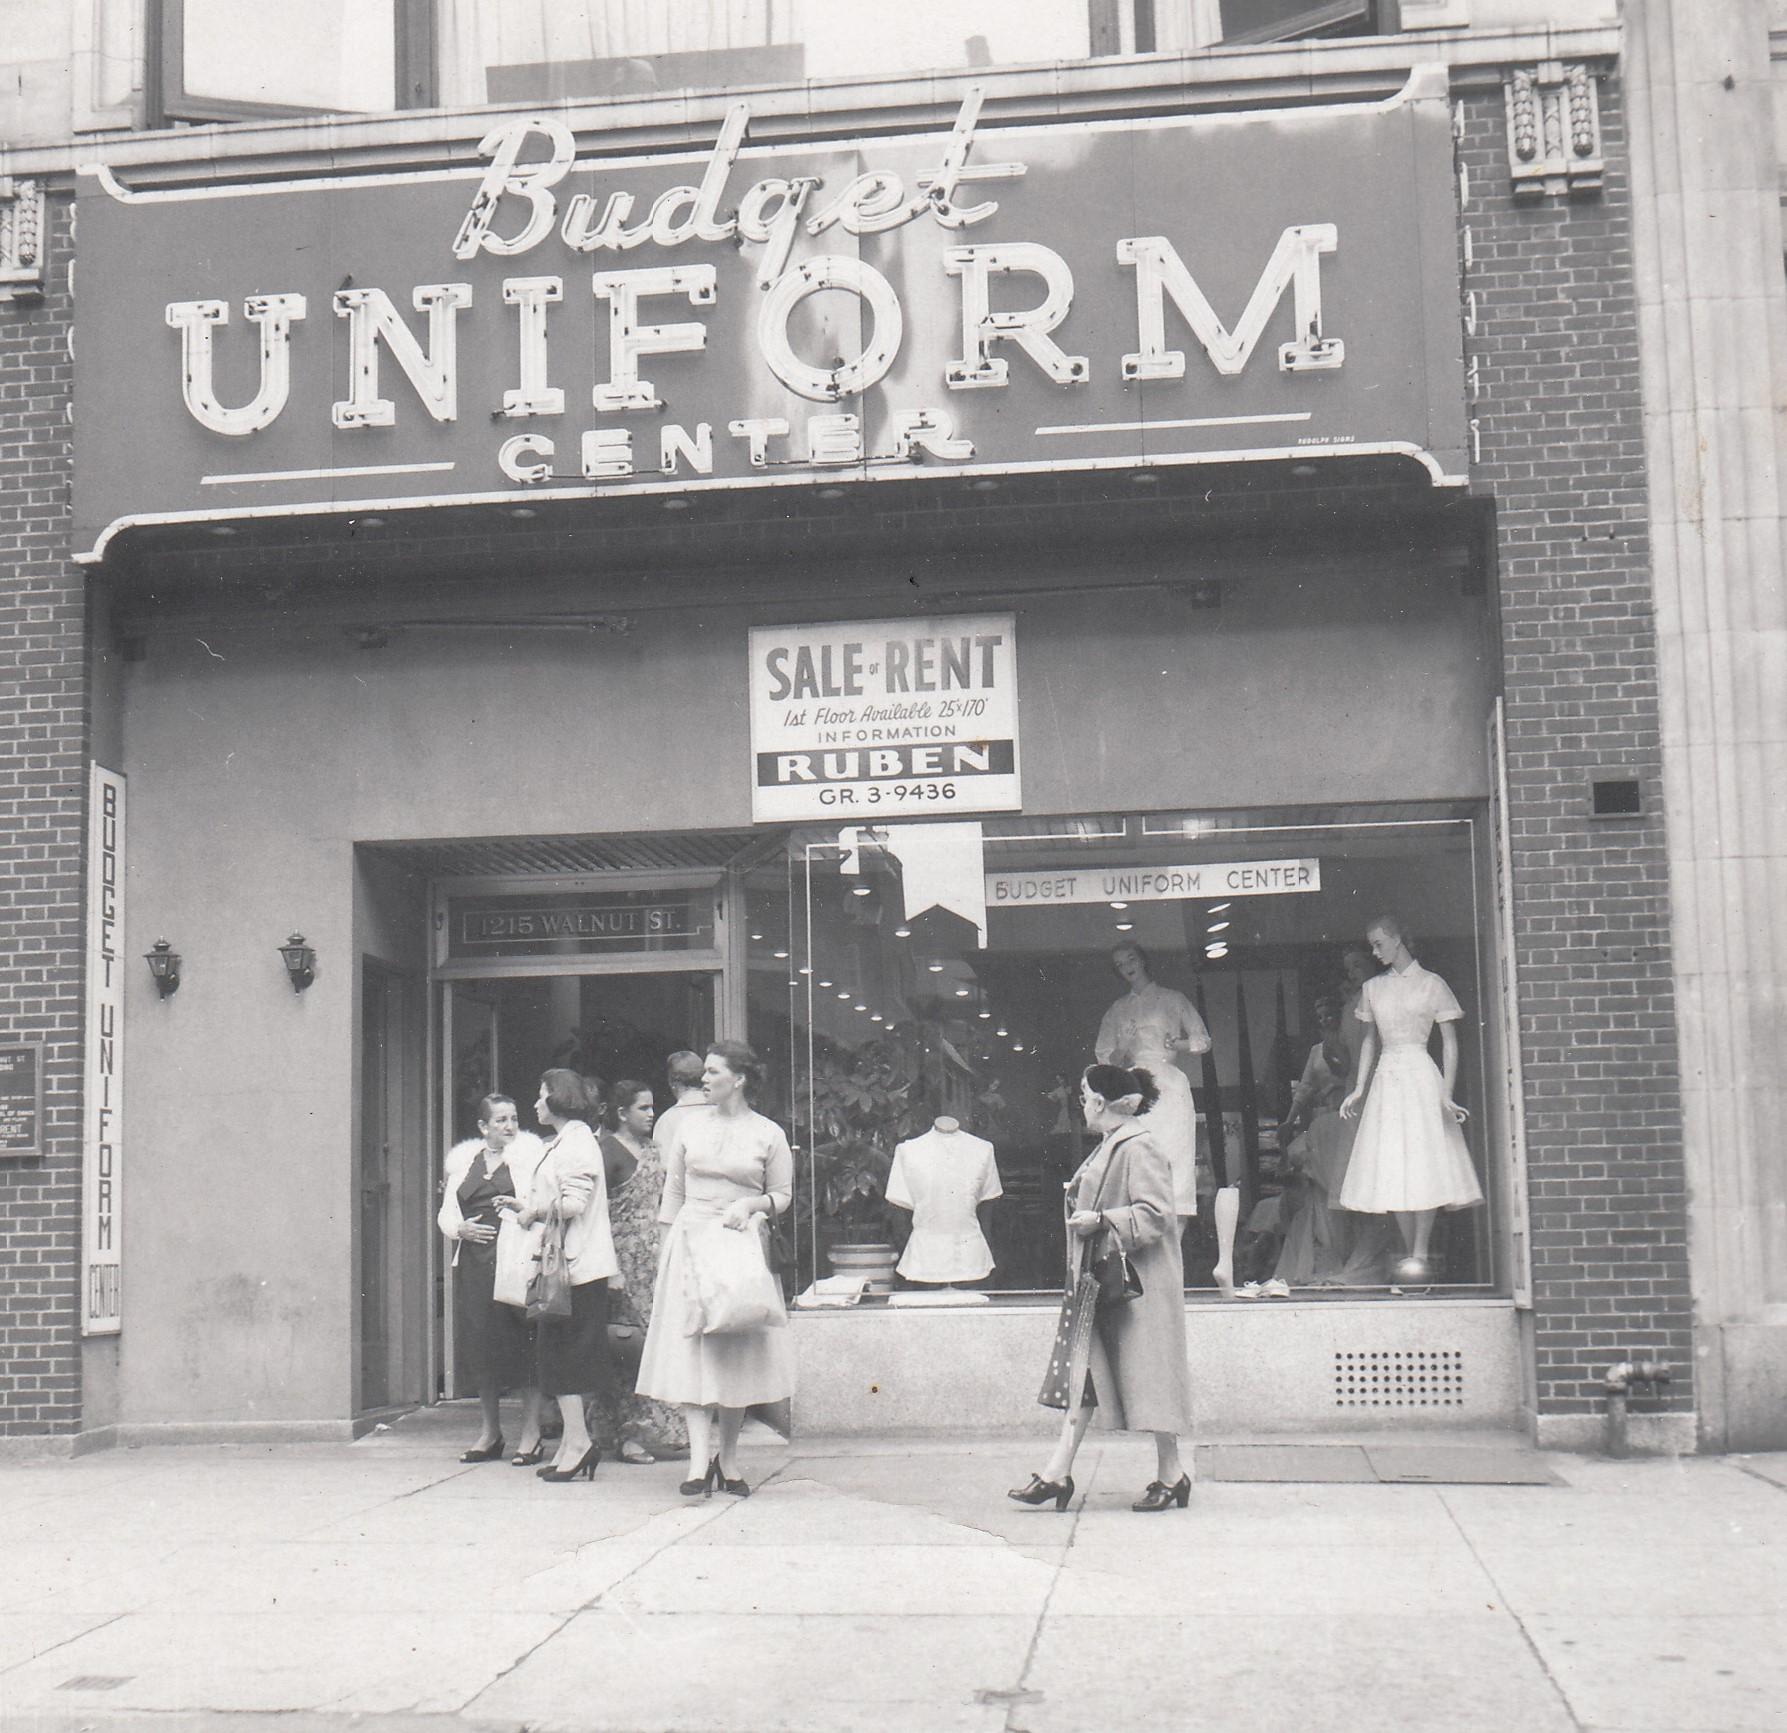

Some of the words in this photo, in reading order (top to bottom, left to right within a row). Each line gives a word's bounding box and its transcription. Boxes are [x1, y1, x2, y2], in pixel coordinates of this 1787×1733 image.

[452, 84, 1028, 290] Budget
[165, 223, 1345, 437] UNIFORM
[498, 408, 976, 484] CENTER
[765, 642, 864, 702] SALE
[869, 662, 880, 676] or
[885, 635, 1002, 694] RENT
[784, 709, 808, 728] 1st
[815, 707, 857, 726] Floor
[860, 703, 932, 723] Available
[818, 725, 957, 744] INFORMATION
[777, 743, 990, 783] RUBEN
[819, 788, 860, 806] GR.
[867, 783, 957, 804] 3-9436
[102, 782, 117, 988] BUDGET
[995, 877, 1077, 901] BUDGET
[1103, 872, 1201, 896] UNIFORM
[1226, 866, 1312, 890] CENTER
[480, 915, 534, 936] 1215
[541, 912, 639, 934] WALNUT
[649, 910, 682, 931] ST.
[98, 1002, 114, 1251] UNIFORM
